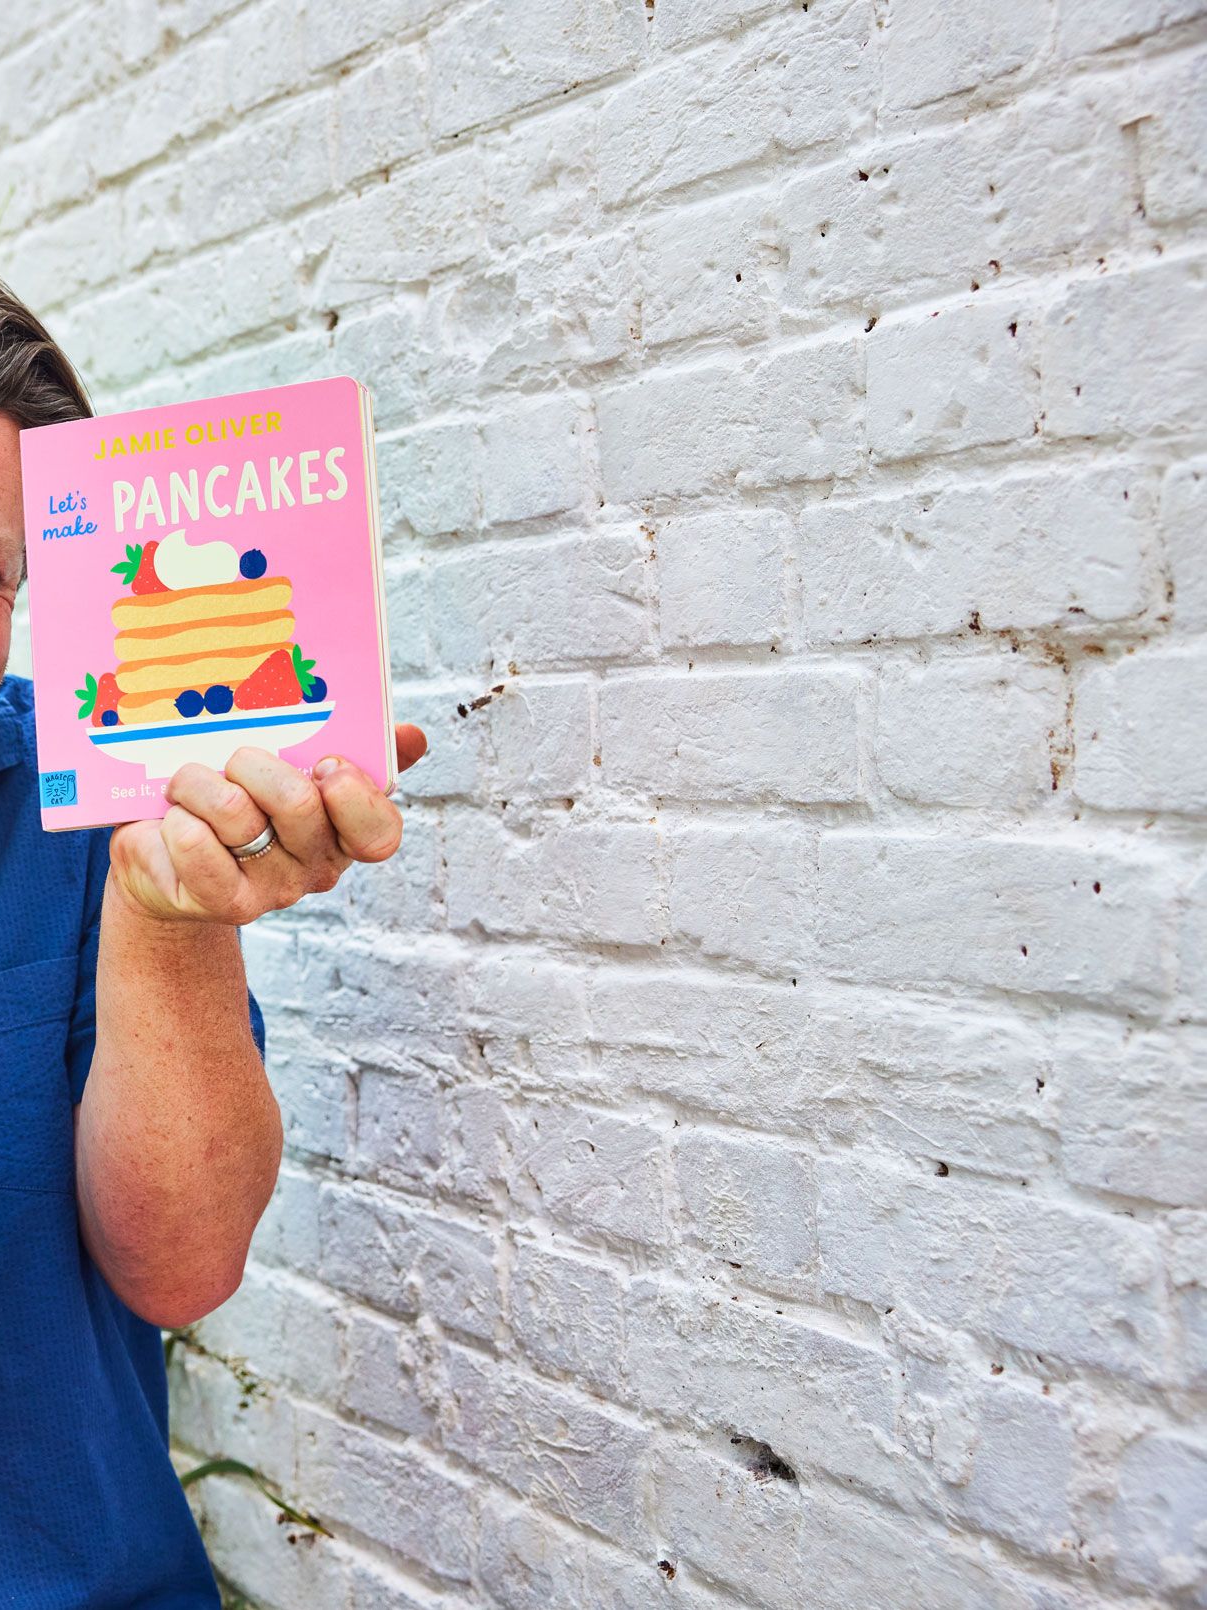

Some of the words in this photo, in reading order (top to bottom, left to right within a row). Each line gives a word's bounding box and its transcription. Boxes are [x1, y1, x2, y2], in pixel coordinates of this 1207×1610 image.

[94, 427, 176, 461] JAMIE
[185, 411, 283, 446] OLIVER
[112, 446, 349, 533] PANCAKES
[49, 491, 87, 515] Let's
[42, 515, 98, 541] make
[50, 797, 64, 805] CAT
[111, 787, 137, 799] See
